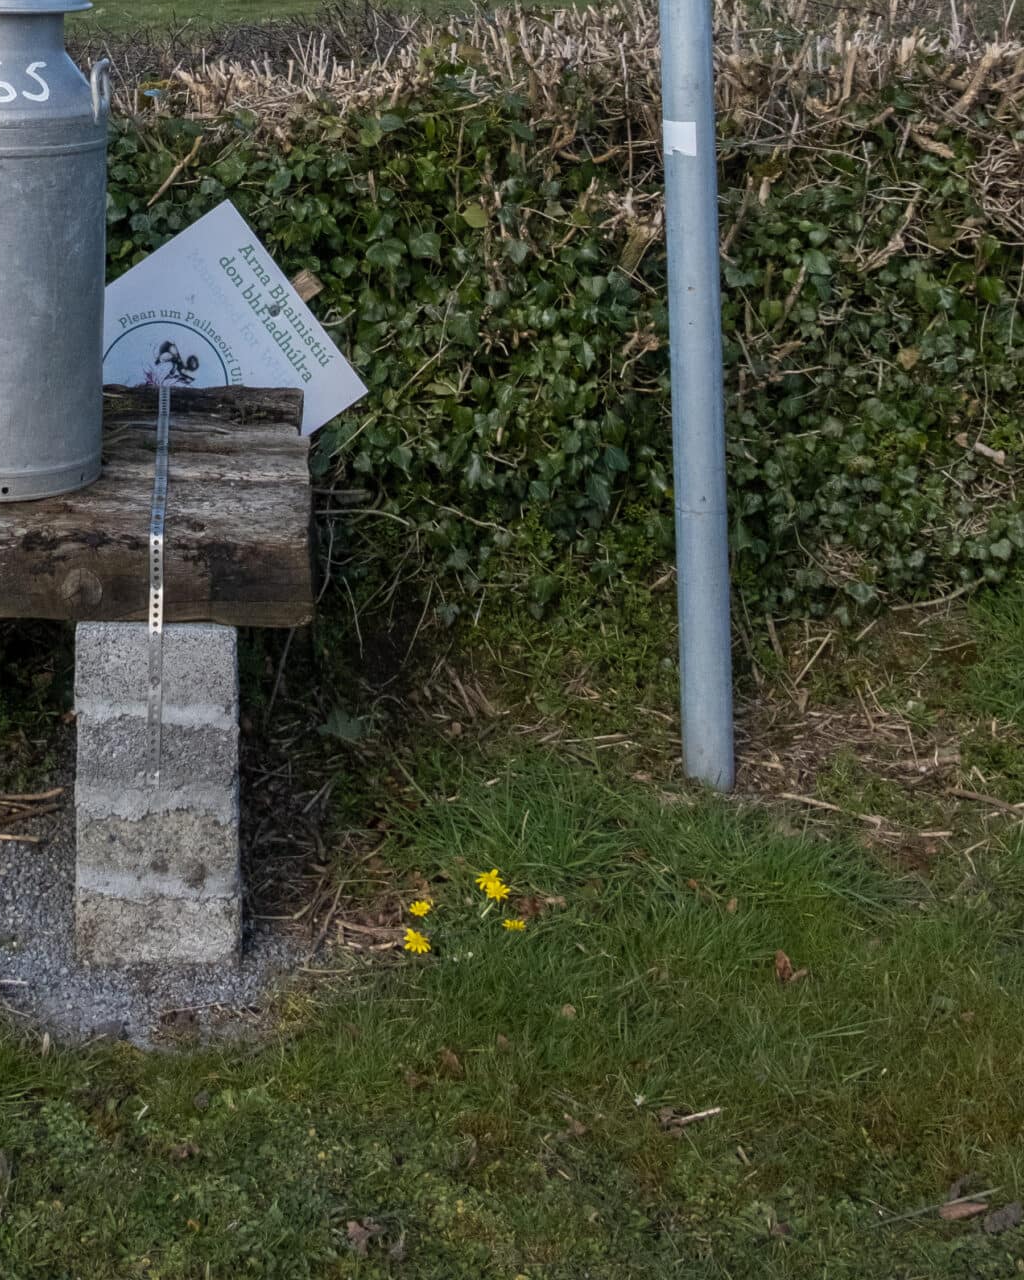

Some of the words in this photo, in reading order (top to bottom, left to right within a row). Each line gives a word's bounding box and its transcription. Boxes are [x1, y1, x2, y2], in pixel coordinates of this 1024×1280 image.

[218, 256, 244, 288] don
[238, 244, 272, 287] Arna
[269, 283, 334, 368] Bhainistiú
[118, 309, 156, 329] Plean
[159, 309, 182, 320] um
[185, 312, 239, 363] Pailneoirí
